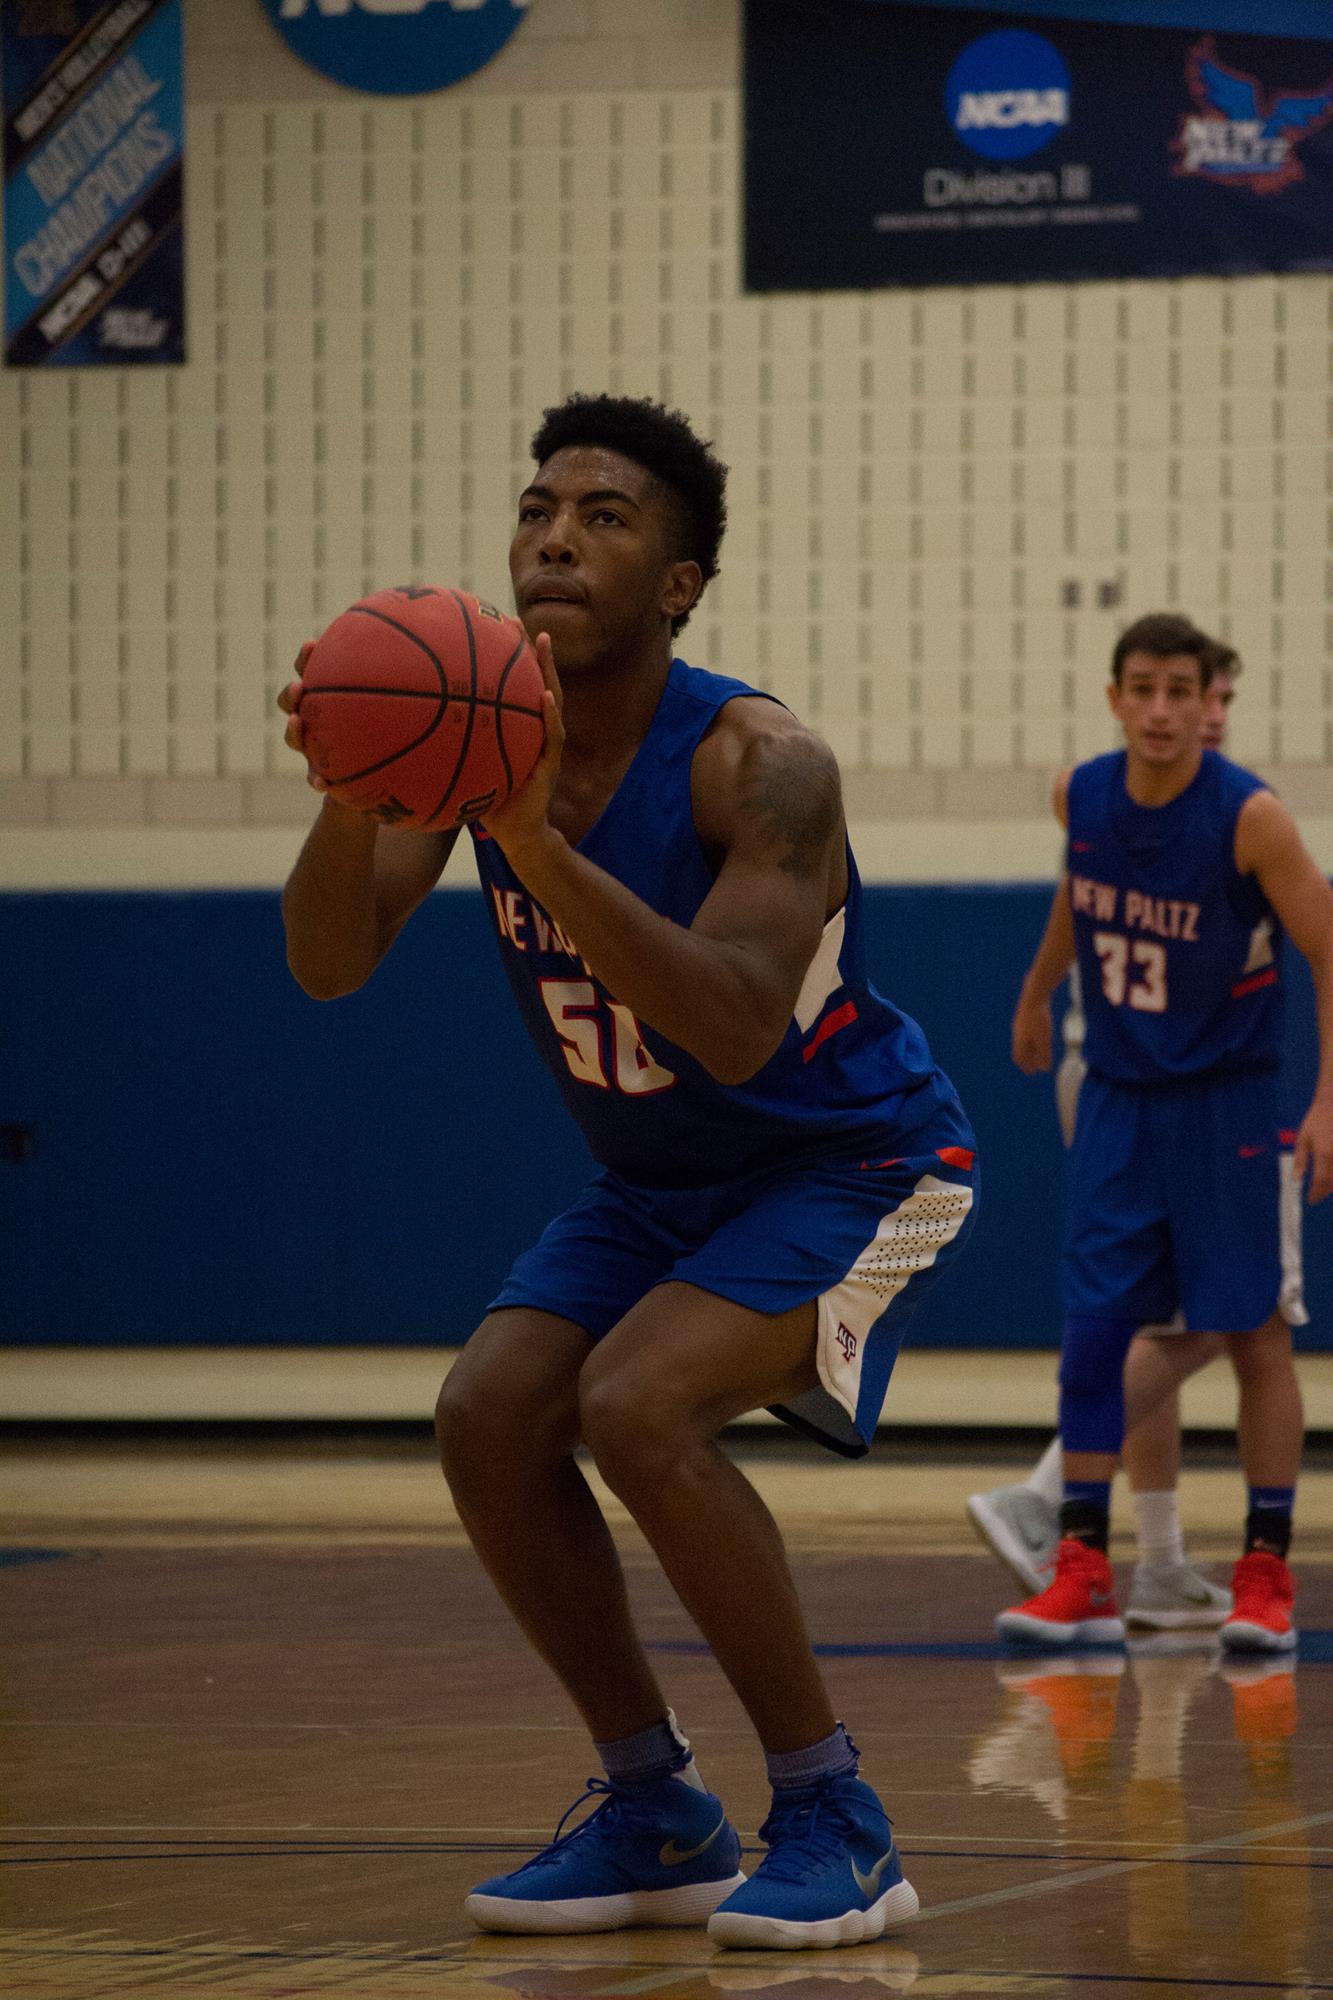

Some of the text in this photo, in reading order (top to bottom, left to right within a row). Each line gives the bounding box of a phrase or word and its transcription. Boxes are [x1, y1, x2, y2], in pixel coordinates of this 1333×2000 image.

[956, 87, 1070, 130] NCAA
[13, 110, 175, 299] CHAMPIONS
[923, 166, 1057, 207] Division
[1124, 888, 1201, 943] PALTZ
